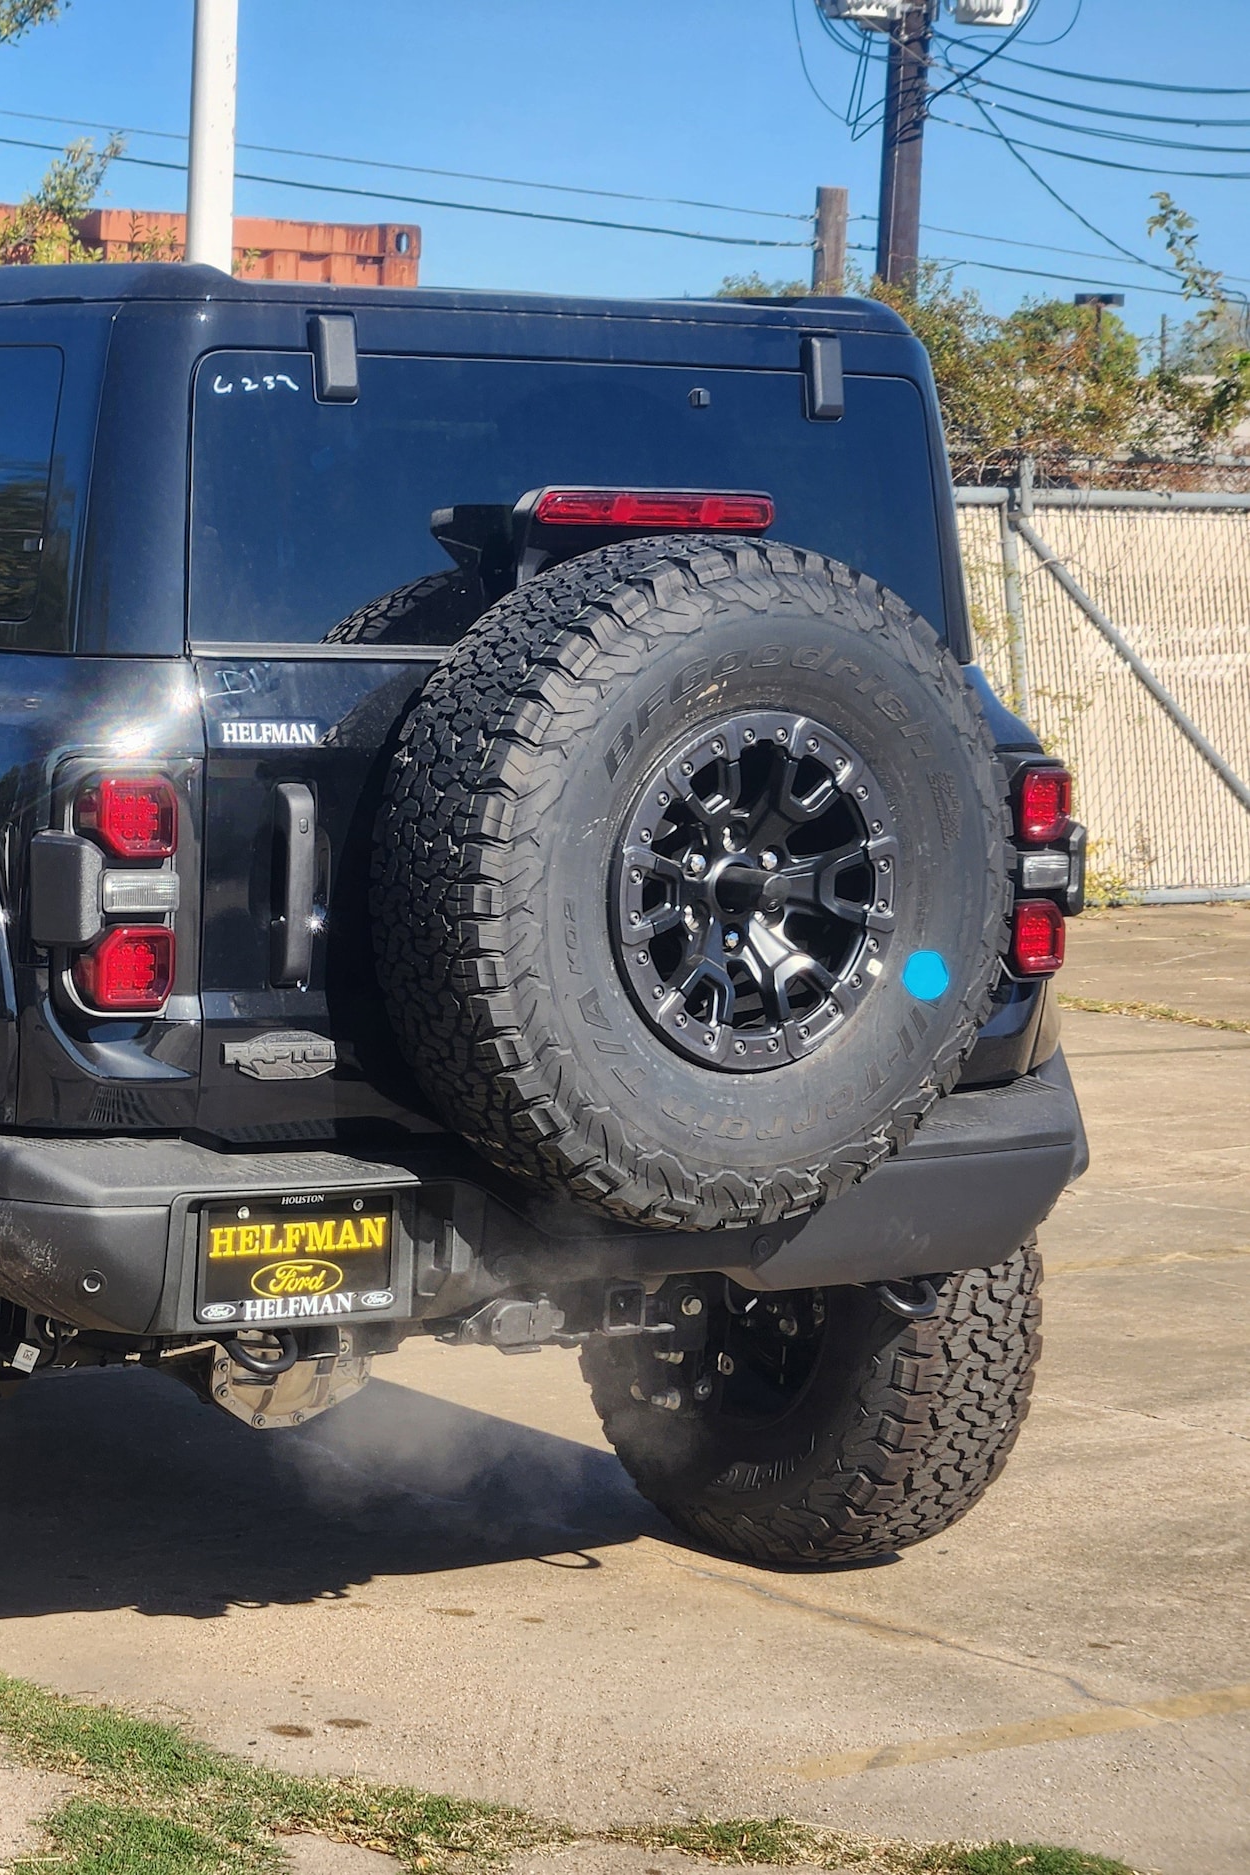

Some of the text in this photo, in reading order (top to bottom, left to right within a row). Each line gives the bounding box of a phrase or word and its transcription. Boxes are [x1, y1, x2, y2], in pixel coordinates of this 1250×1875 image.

[603, 642, 935, 782] BFGoodrich
[221, 722, 317, 744] HELFMAN
[660, 1000, 940, 1141] ll-Terrain
[281, 1194, 325, 1205] HOUSTON
[208, 1216, 387, 1258] HELFMAN
[268, 1263, 327, 1292] Ford
[243, 1292, 355, 1321] HELFMAN
